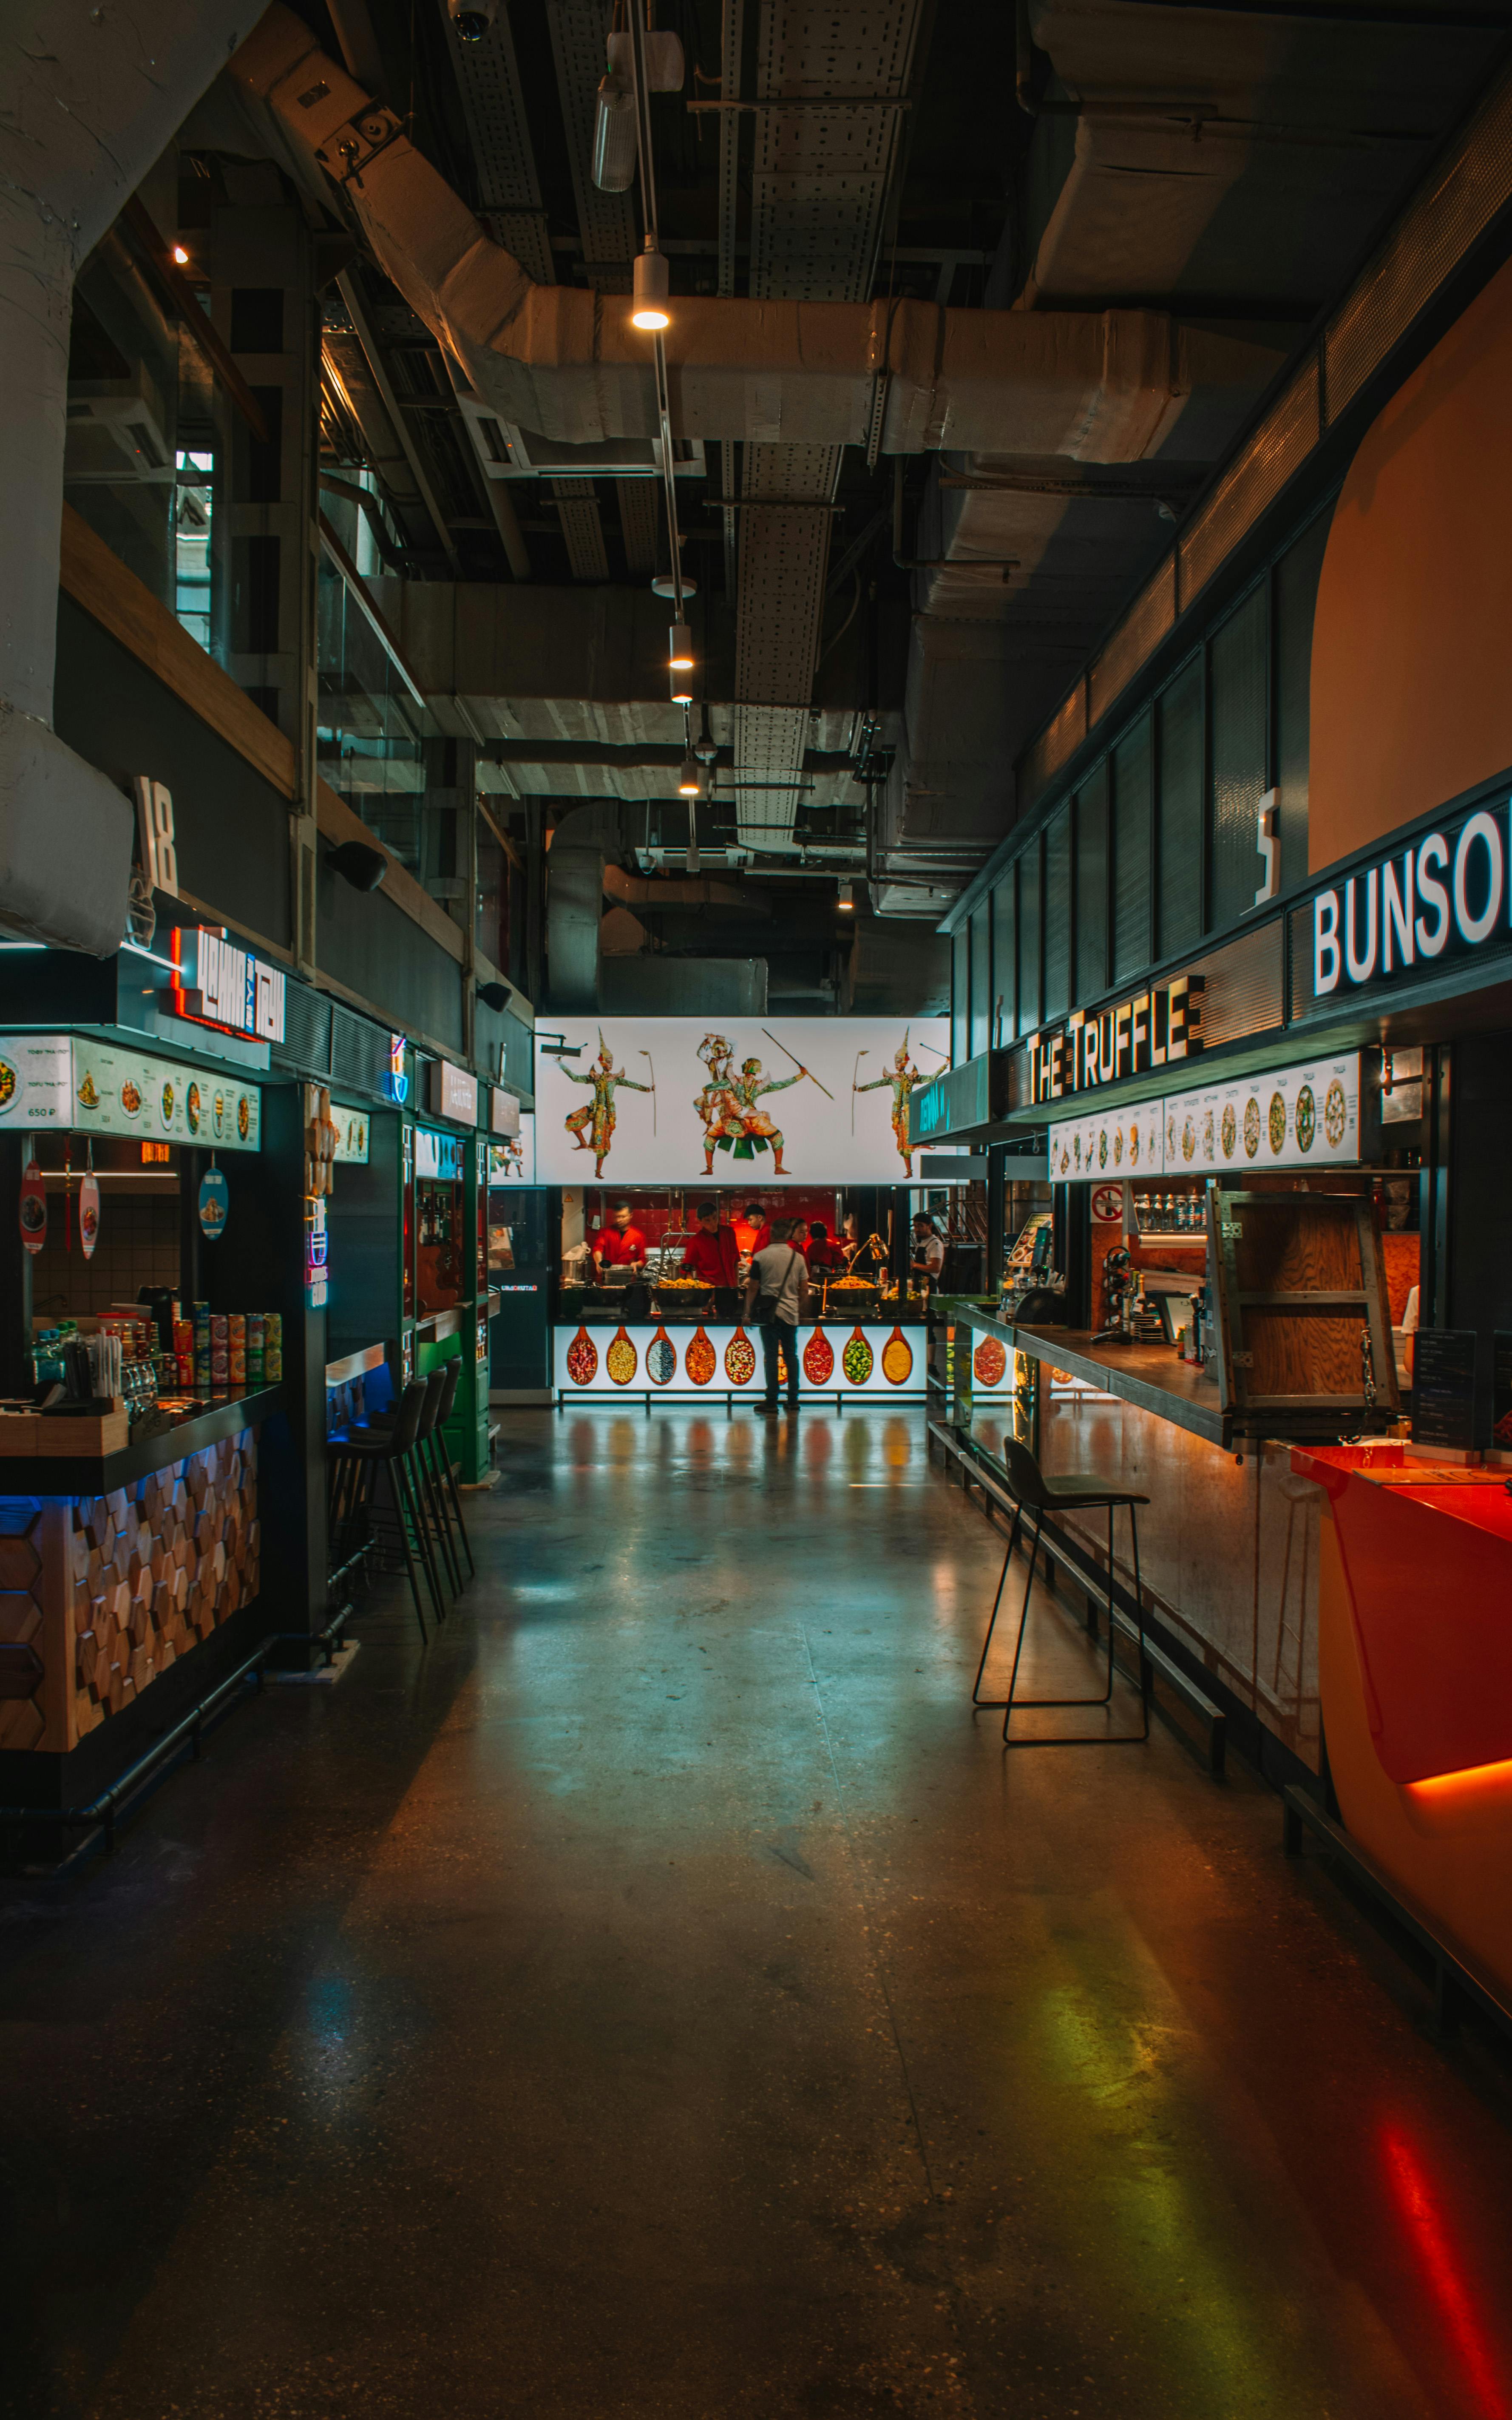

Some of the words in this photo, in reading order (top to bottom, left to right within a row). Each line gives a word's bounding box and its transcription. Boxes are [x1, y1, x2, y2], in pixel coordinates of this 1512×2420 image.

[134, 776, 178, 898] 18
[1314, 796, 1512, 996] BUNSO
[1027, 1033, 1063, 1104] THE
[1068, 976, 1190, 1091] TRUFFLE
